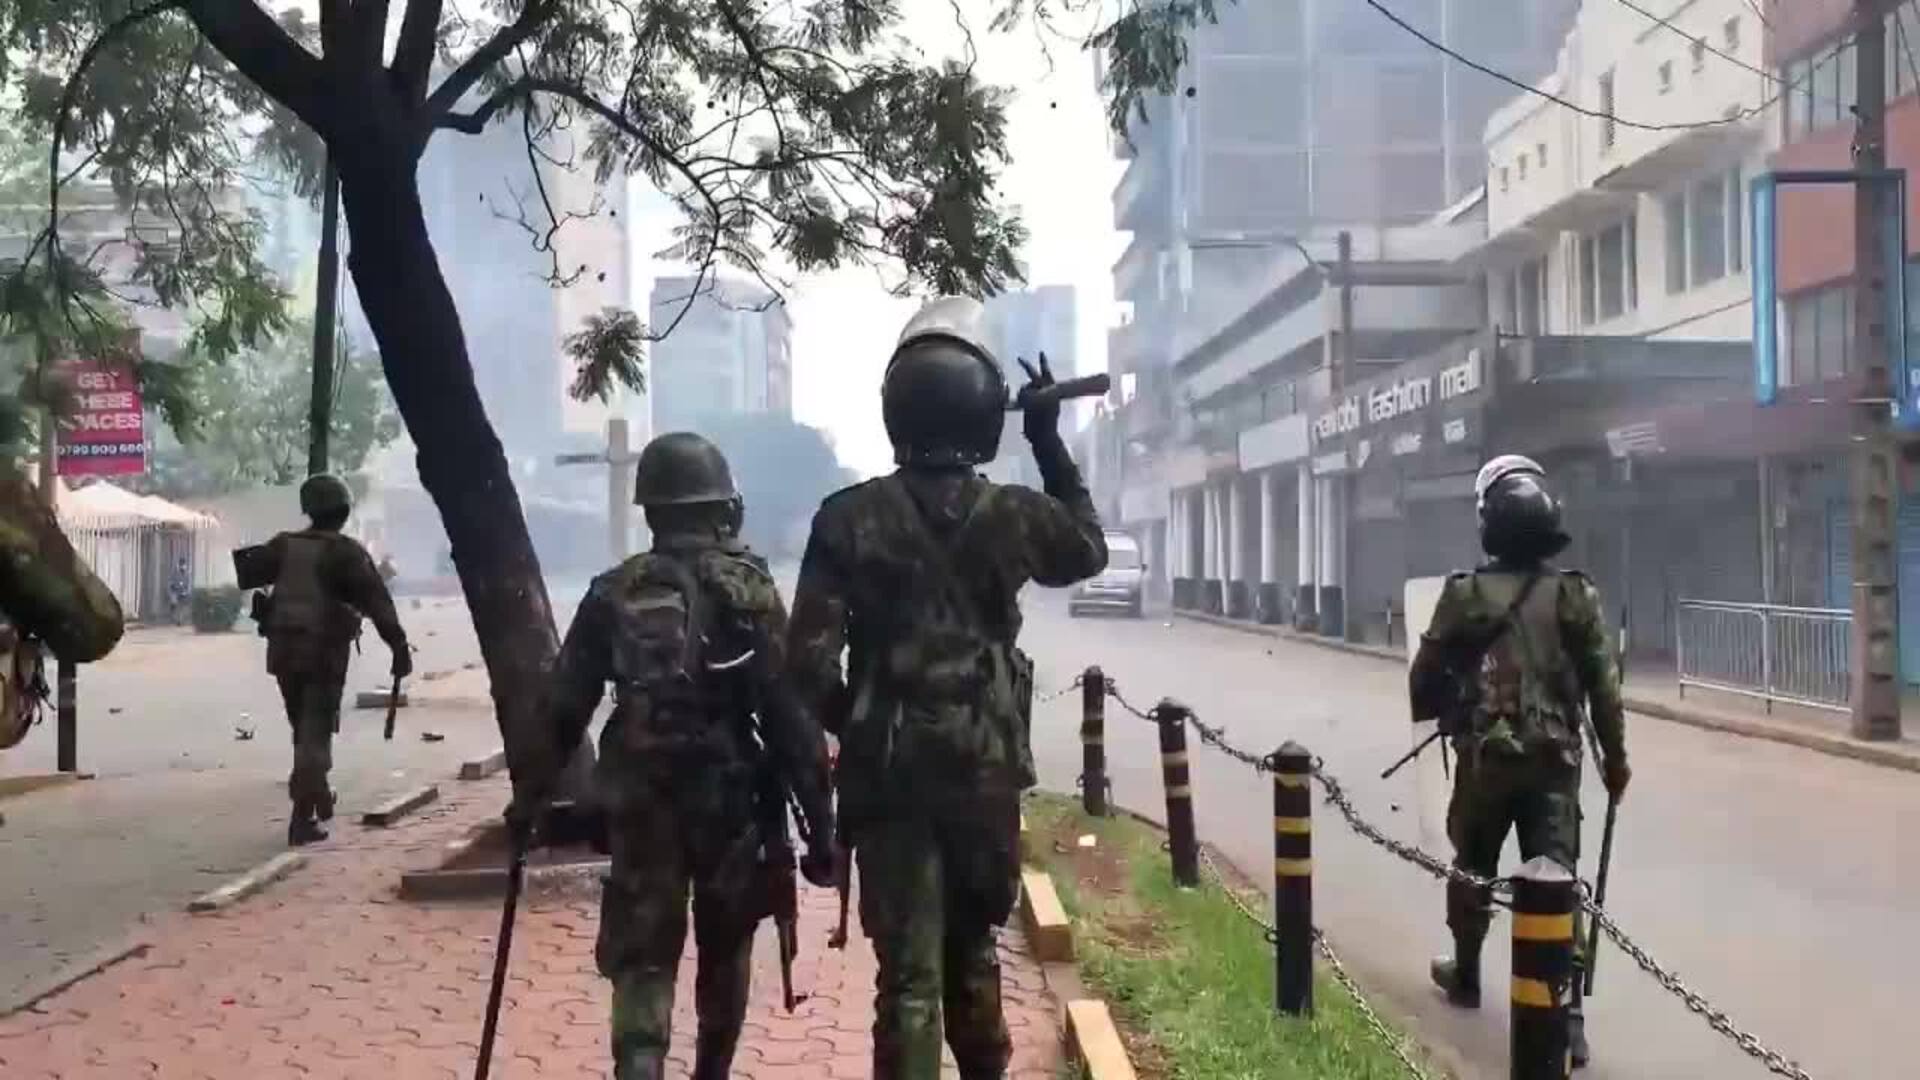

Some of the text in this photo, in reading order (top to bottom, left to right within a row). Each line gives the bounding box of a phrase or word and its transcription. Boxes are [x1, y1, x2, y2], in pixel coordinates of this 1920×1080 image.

[77, 371, 119, 390] GET
[1368, 378, 1432, 423] fashion
[1440, 348, 1480, 401] mall
